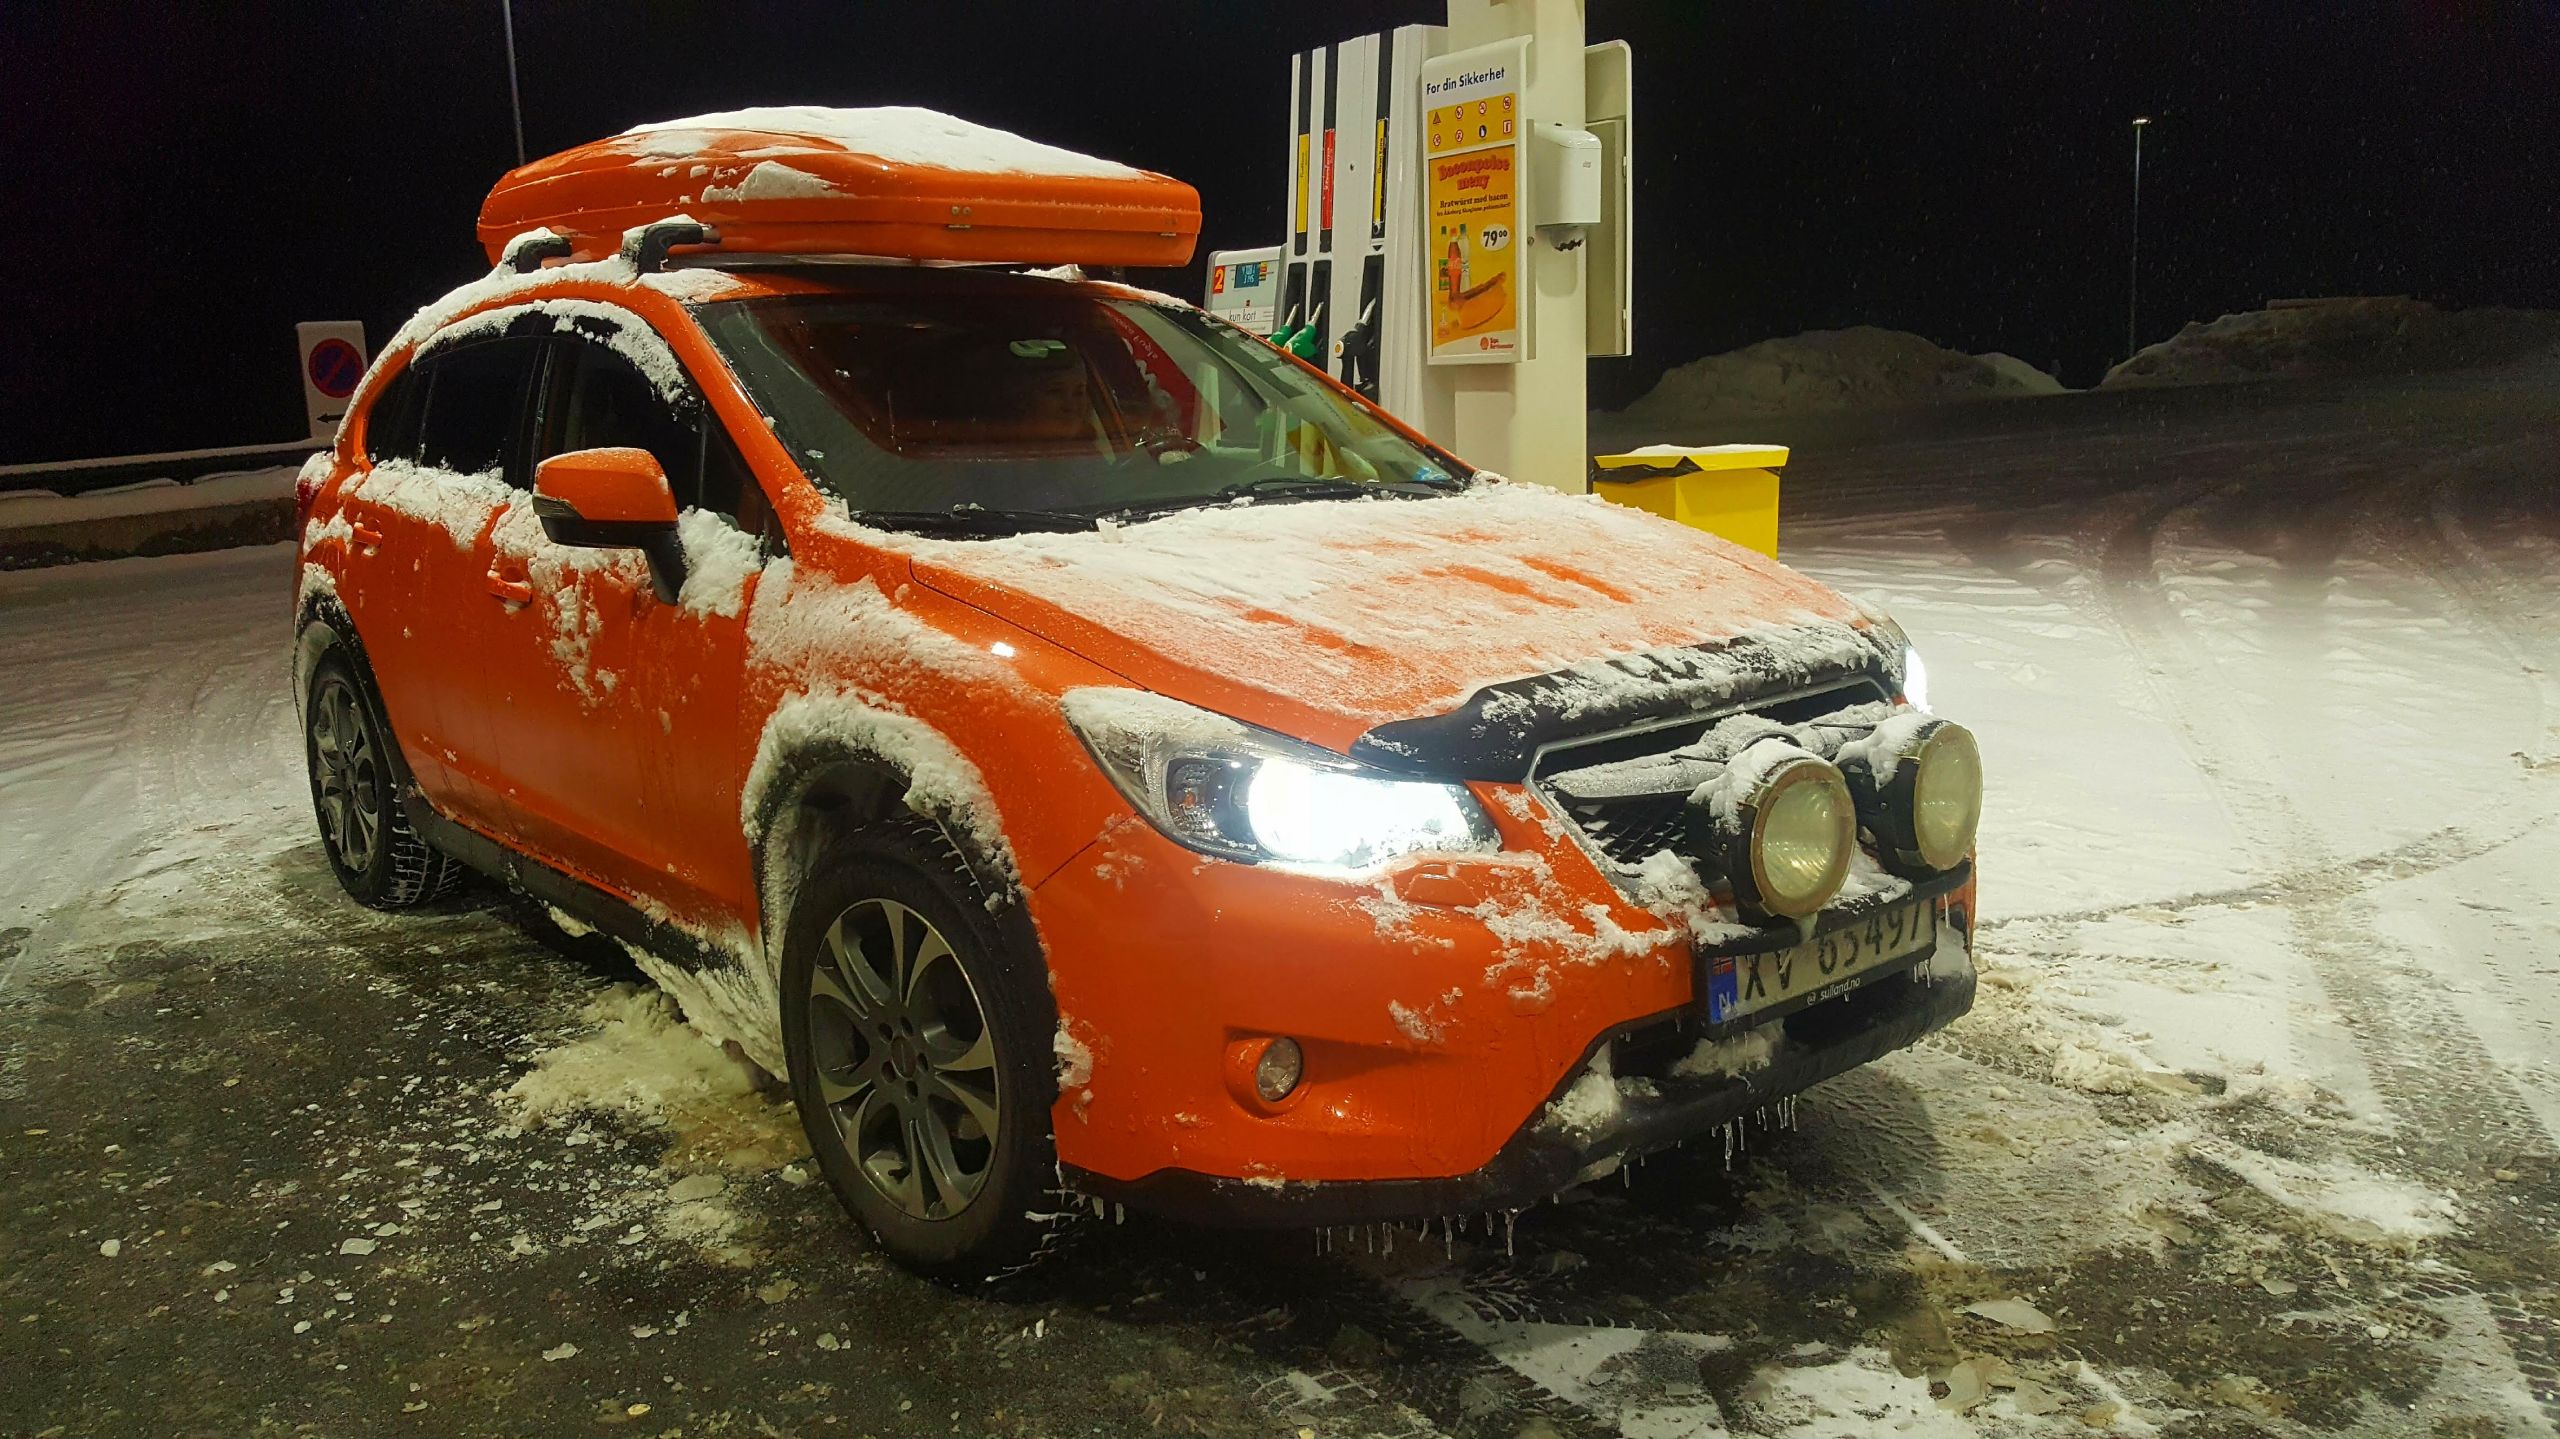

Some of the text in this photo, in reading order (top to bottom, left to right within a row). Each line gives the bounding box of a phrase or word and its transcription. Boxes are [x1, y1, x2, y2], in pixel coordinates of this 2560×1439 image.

[1426, 67, 1505, 95] For din Sikkerhet
[1214, 268, 1224, 290] 2
[1229, 309, 1241, 322] kun
[1820, 977, 1861, 1001] sulland.no
